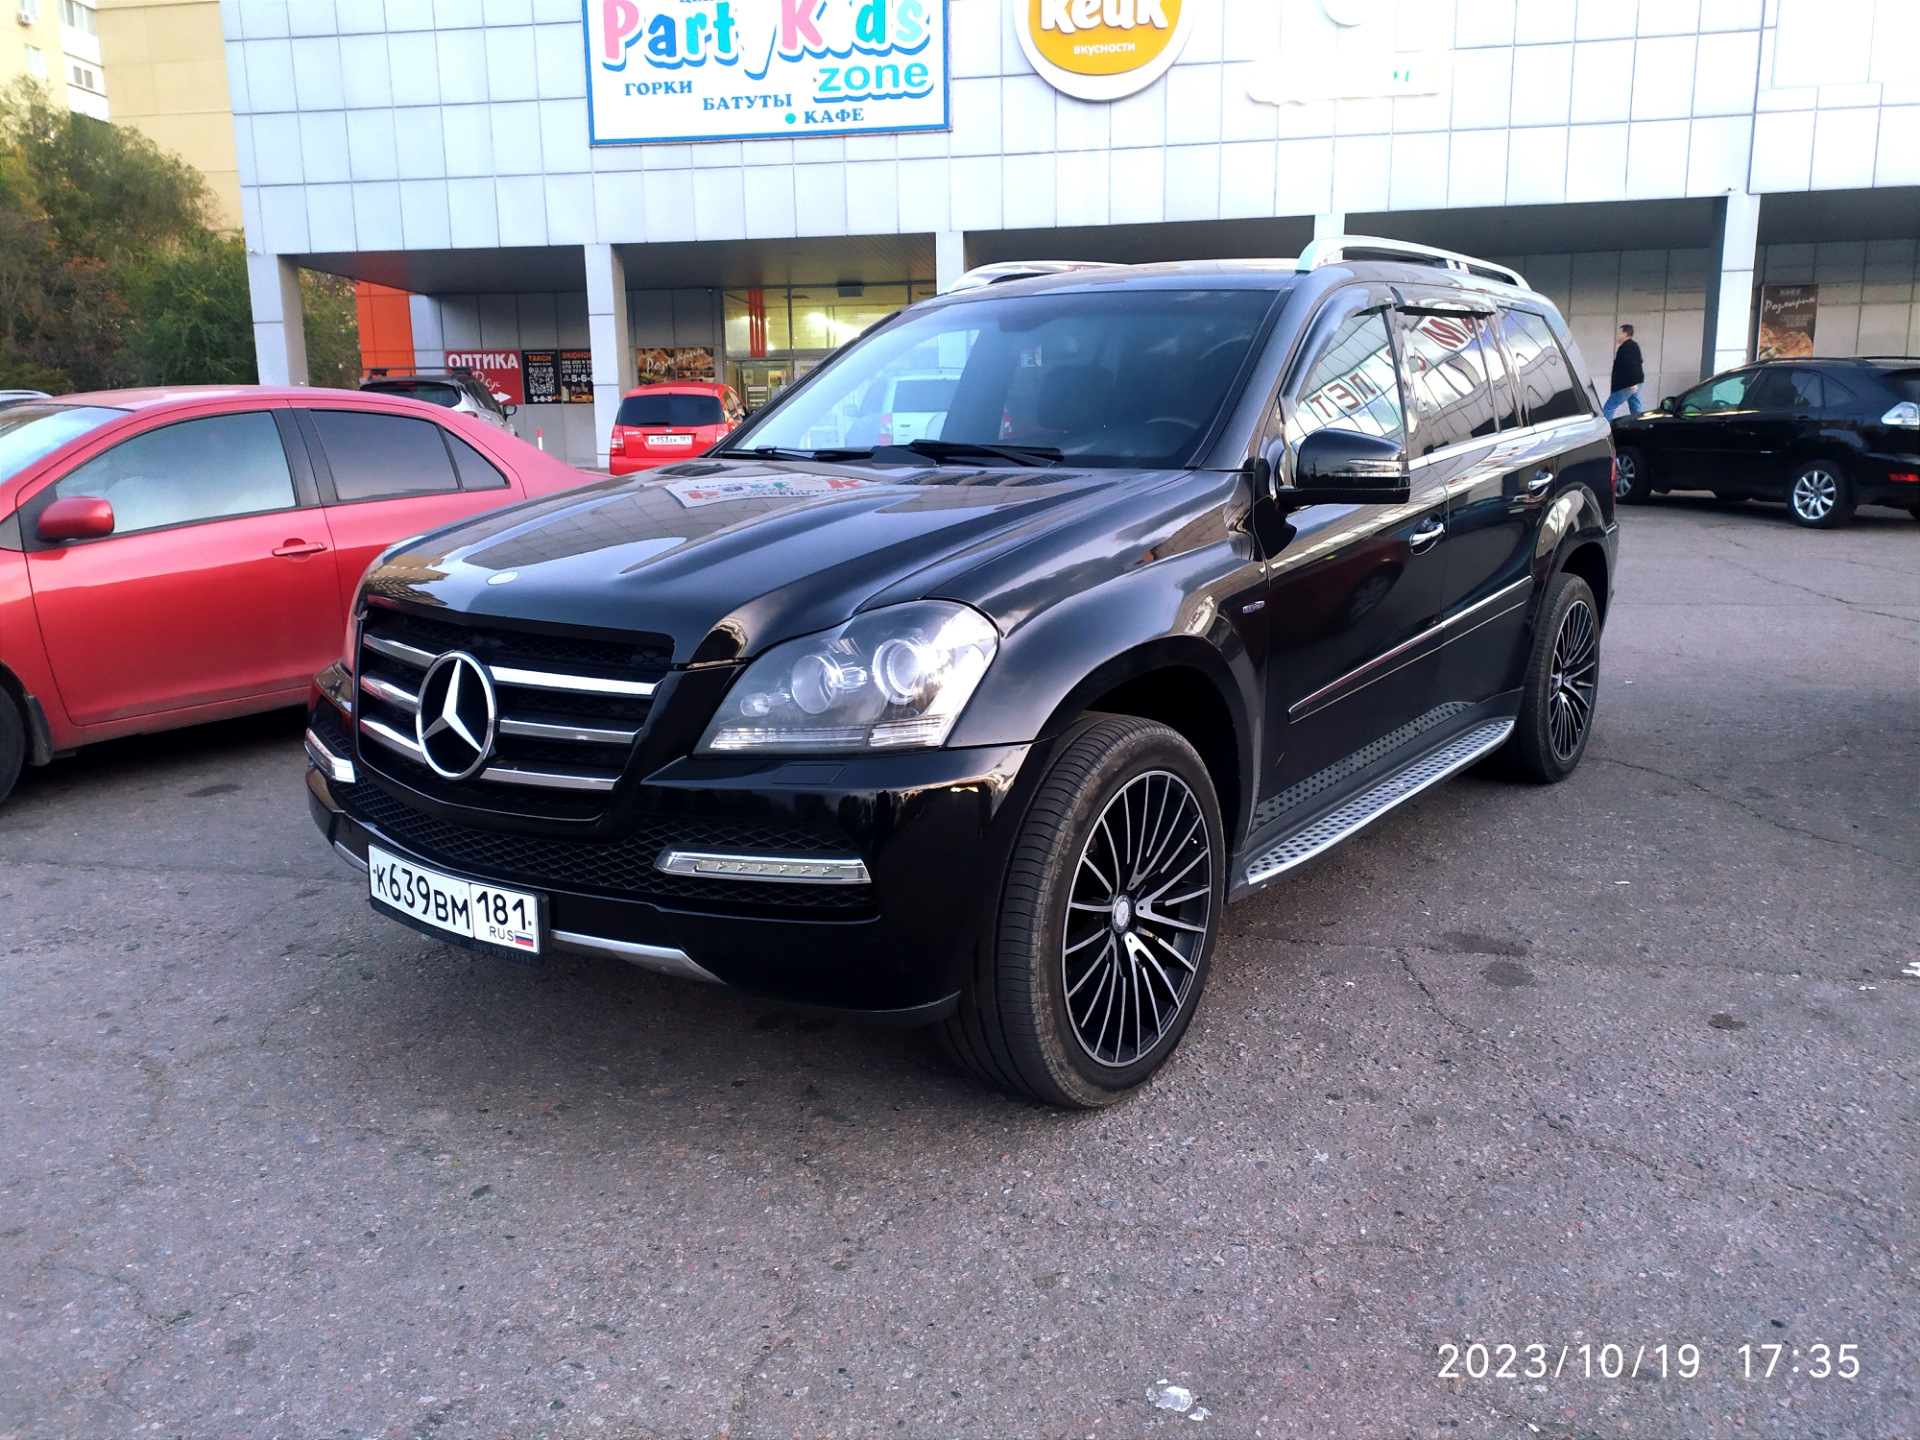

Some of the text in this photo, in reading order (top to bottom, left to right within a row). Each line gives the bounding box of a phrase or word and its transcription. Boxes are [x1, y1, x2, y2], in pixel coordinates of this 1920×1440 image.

[780, 0, 931, 57] Kds
[1073, 41, 1135, 56] вкусности
[817, 62, 930, 92] zone
[624, 80, 693, 97] ГОРКИ
[702, 93, 793, 112] БАТУТЫ
[803, 108, 865, 125] КАФЕ
[448, 353, 519, 370] ОПТИКА
[376, 863, 527, 931] К639ВМ 181
[489, 926, 515, 942] RUS
